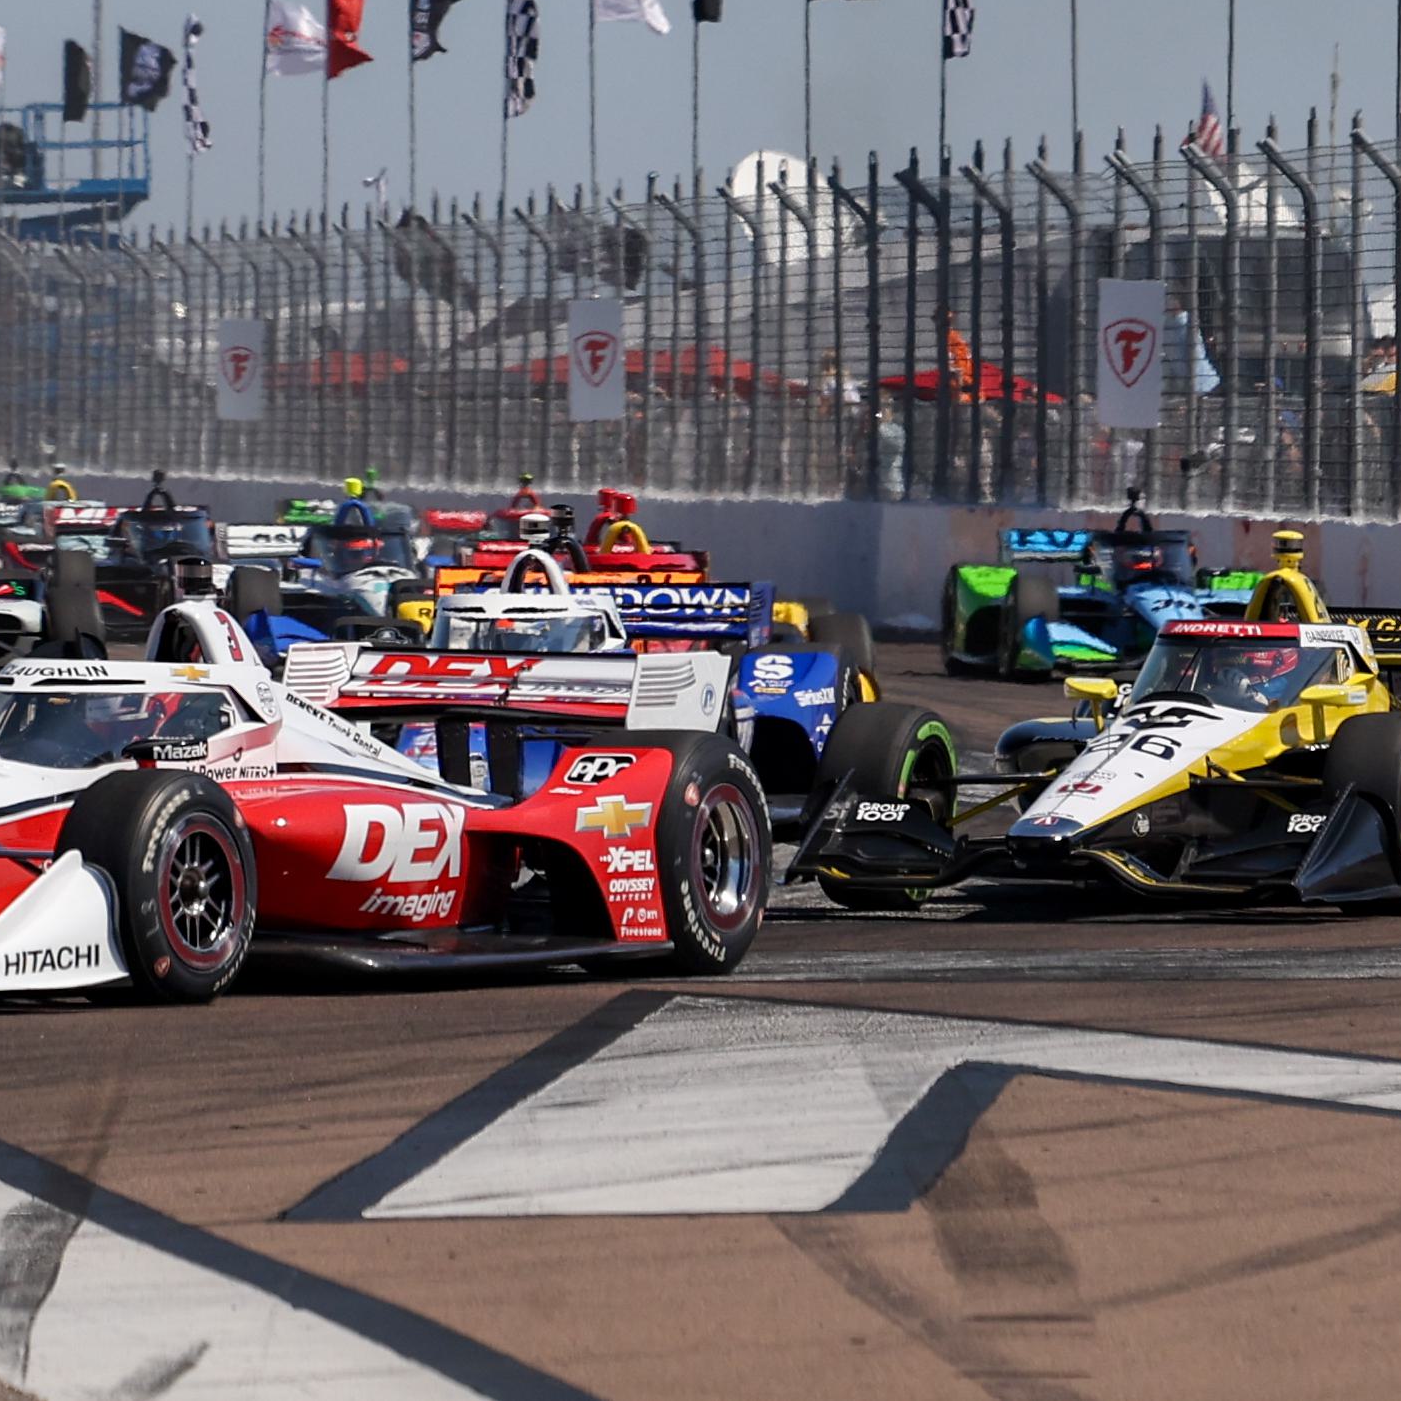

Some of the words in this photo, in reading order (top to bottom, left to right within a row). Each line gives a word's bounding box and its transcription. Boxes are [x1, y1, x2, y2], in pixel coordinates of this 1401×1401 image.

[1171, 624, 1262, 636] ANDRETTI
[153, 741, 208, 760] Mazak
[1081, 733, 1182, 760] 26
[858, 802, 911, 812] GROUP
[856, 810, 905, 822] 1001
[325, 802, 465, 883] DEX
[606, 847, 654, 873] XPEL
[609, 878, 654, 893] ODYSSEY
[359, 886, 456, 922] imaging
[609, 892, 652, 903] BATTERY
[621, 926, 662, 938] Firestone
[4, 944, 100, 977] HITACHI
